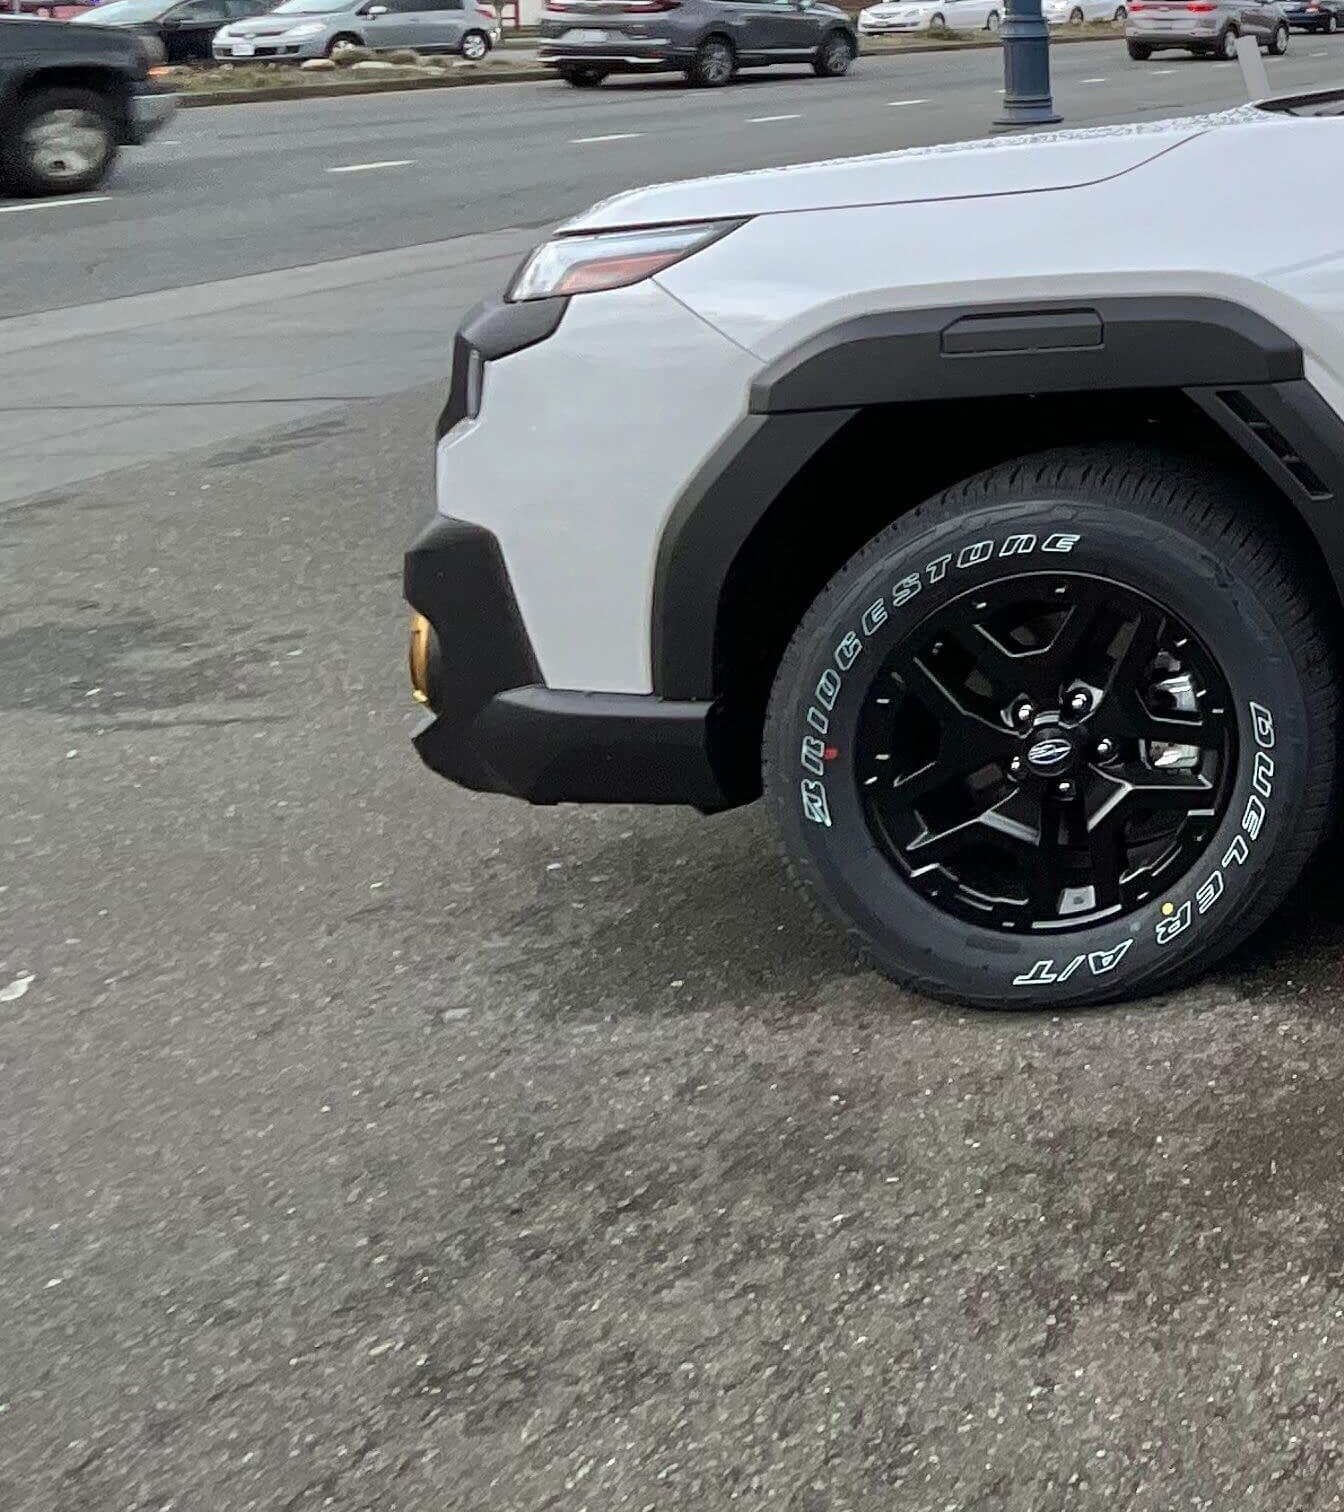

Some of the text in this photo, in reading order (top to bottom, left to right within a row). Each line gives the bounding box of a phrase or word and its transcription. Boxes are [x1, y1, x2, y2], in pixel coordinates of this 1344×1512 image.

[800, 533, 1081, 827] BRIDGESTONE
[1012, 701, 1275, 985] DUELER A/T
